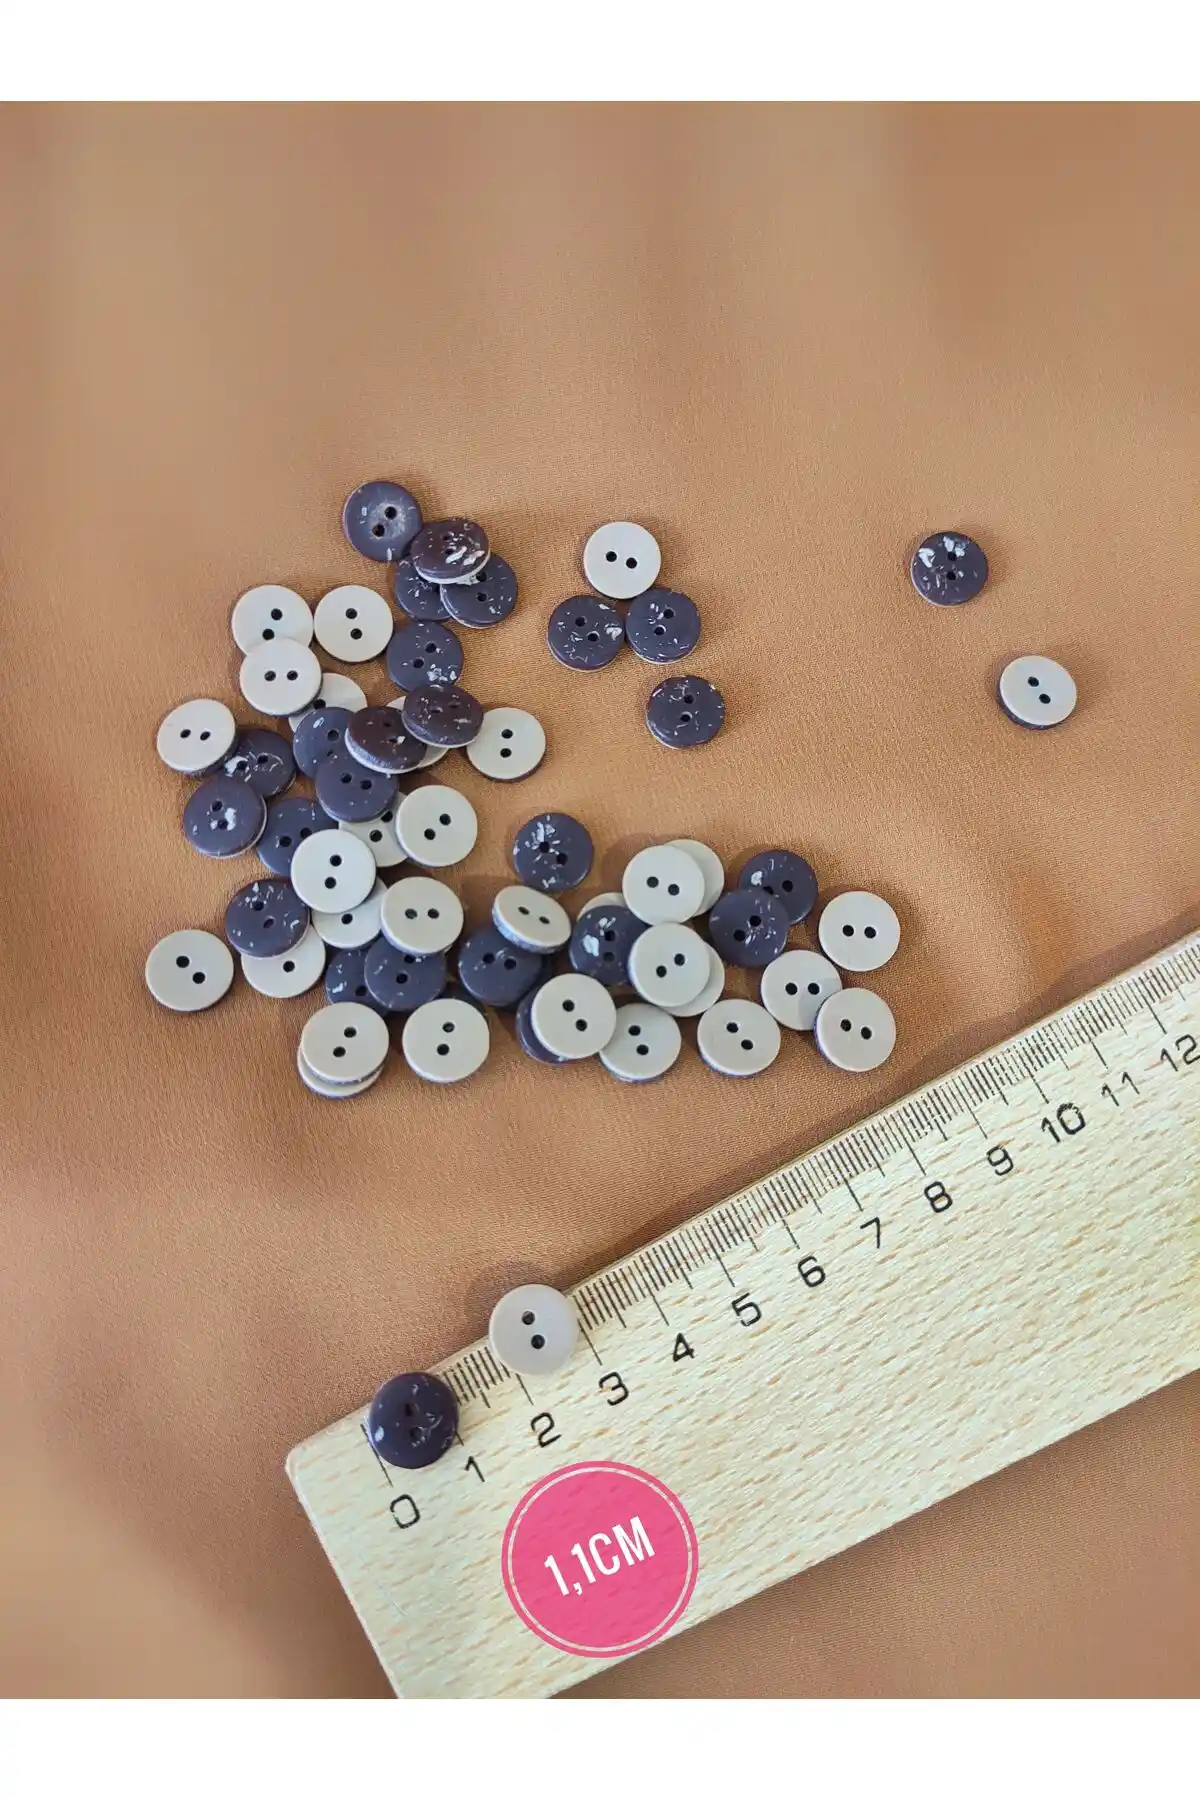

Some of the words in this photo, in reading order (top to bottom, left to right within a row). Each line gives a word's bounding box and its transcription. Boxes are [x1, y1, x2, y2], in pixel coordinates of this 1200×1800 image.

[389, 1493, 421, 1529] 0
[464, 1455, 486, 1483] 1
[530, 1412, 562, 1448] 2
[598, 1371, 630, 1406] 3
[672, 1332, 695, 1363] 4
[730, 1292, 763, 1327] 5
[797, 1255, 826, 1288] 6
[859, 1216, 881, 1249] 7
[923, 1180, 954, 1214] 8
[986, 1145, 1015, 1176] 9
[1040, 1102, 1086, 1143] 10
[1101, 1071, 1141, 1107] 11
[1160, 1034, 1200, 1072] 12
